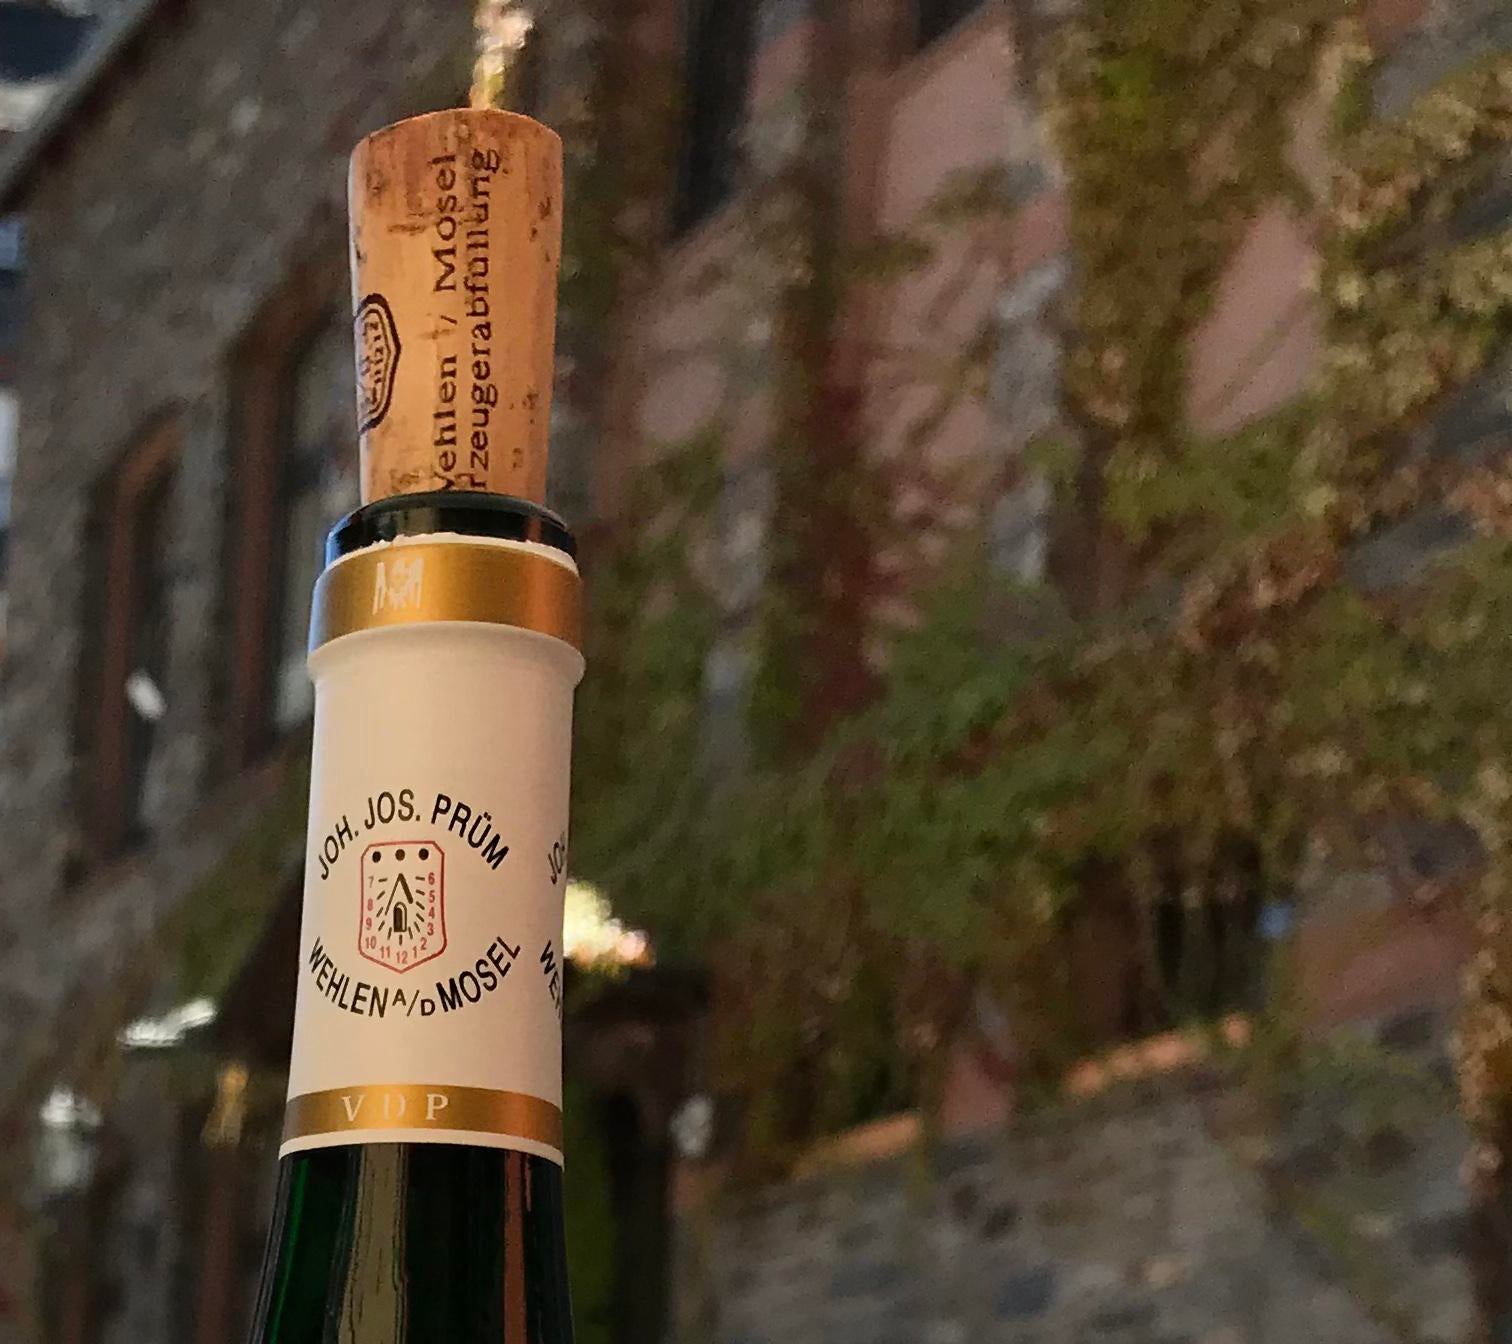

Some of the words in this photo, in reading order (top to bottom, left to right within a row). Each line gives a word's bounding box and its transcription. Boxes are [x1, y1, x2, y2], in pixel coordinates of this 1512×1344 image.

[431, 154, 457, 292] Mosel
[318, 814, 359, 881] JOH.
[364, 788, 421, 830] JOS.
[431, 792, 510, 871] PRÜM
[368, 876, 374, 888] 7
[428, 872, 435, 885] 6
[429, 890, 435, 903] 5
[367, 898, 374, 911] 8
[428, 906, 435, 919] 4
[366, 917, 372, 930] 9
[427, 922, 434, 936] 3
[365, 936, 376, 949] 10
[420, 937, 428, 950] 2
[380, 946, 390, 958] 11
[396, 950, 408, 964] 12
[308, 936, 389, 1018] WEHLEN
[435, 936, 521, 1013] MOSEL
